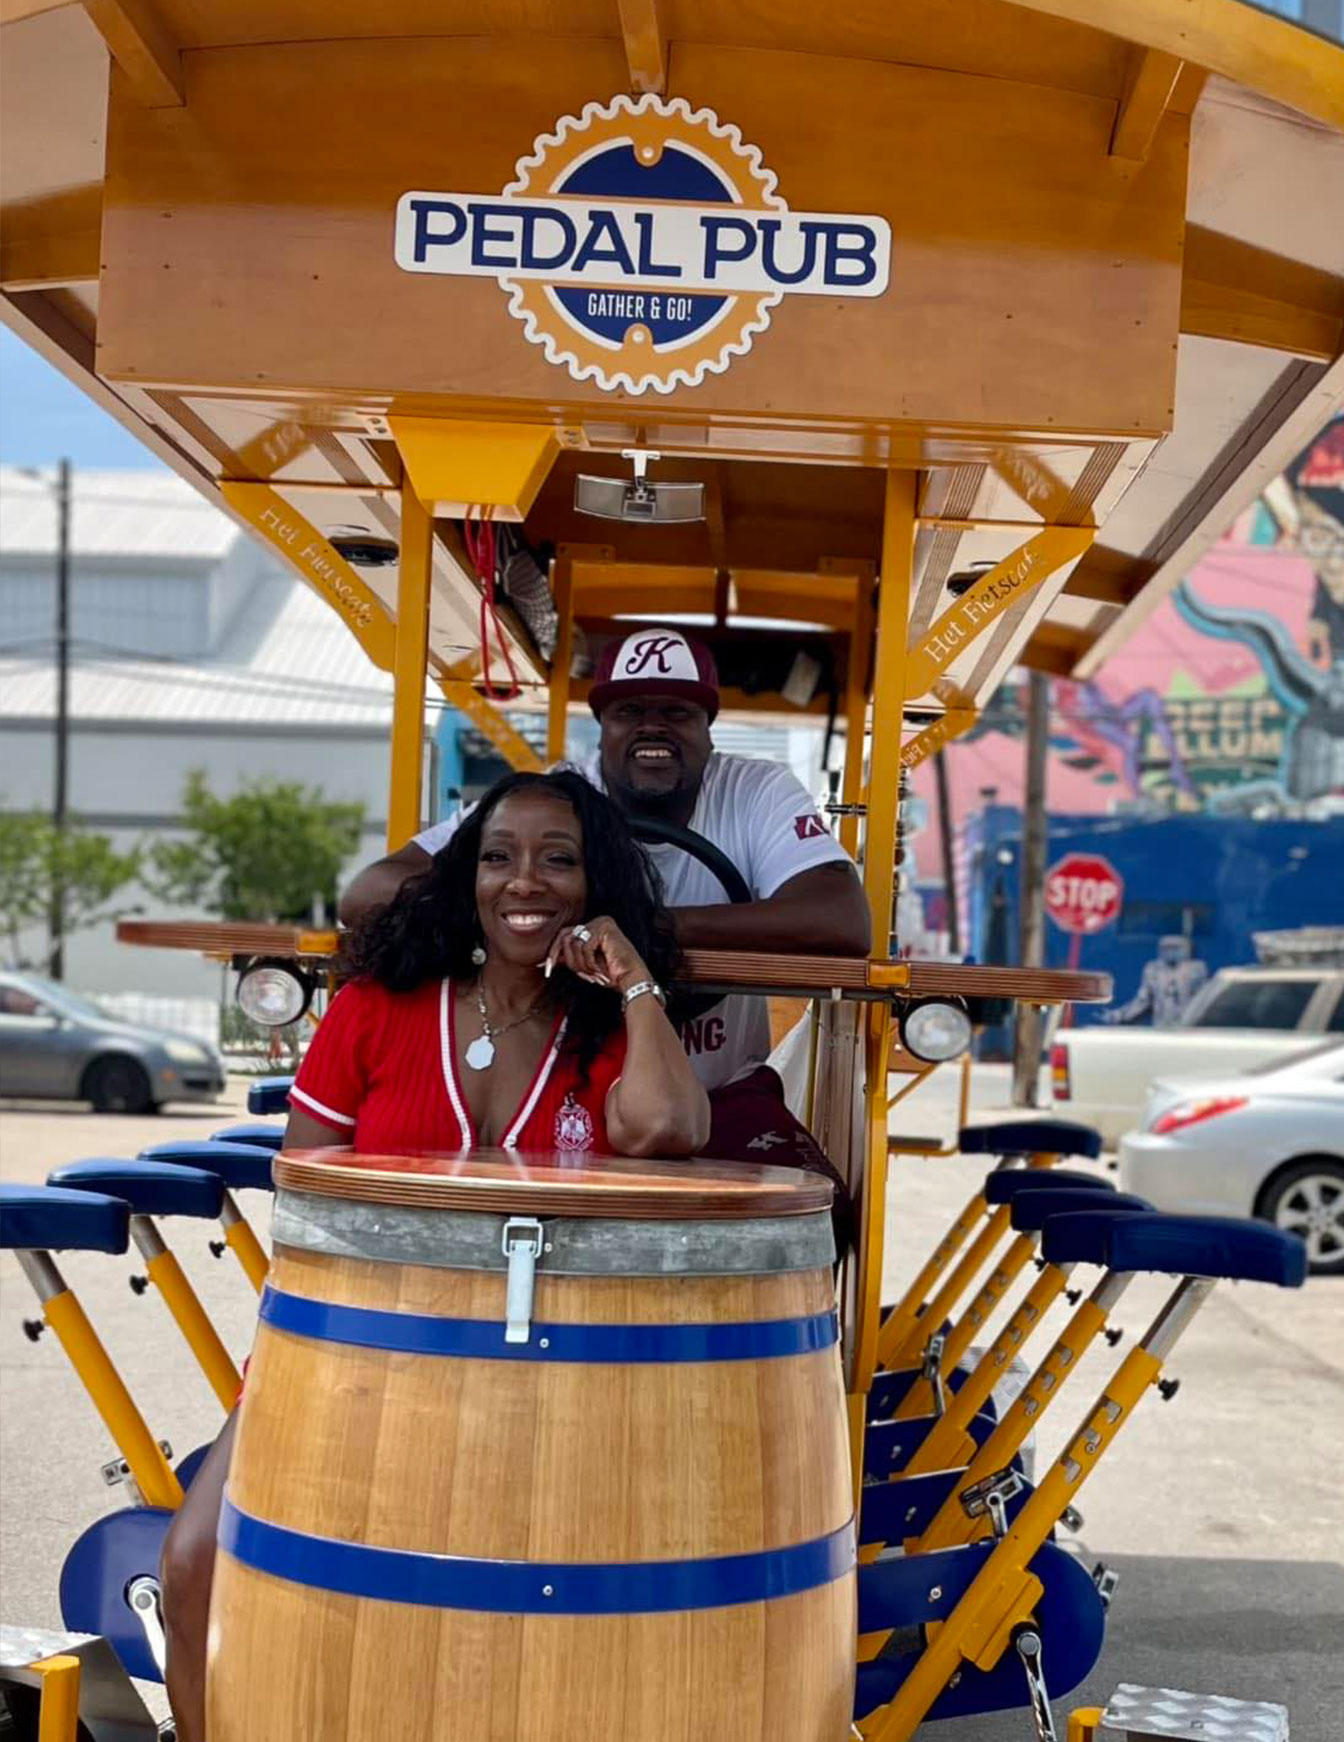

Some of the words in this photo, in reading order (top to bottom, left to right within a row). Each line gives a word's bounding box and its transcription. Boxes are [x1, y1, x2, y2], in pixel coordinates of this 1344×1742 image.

[410, 200, 682, 277] PEDAL
[700, 216, 877, 286] PUB
[587, 292, 645, 319] GATHER
[650, 297, 662, 321] &
[667, 298, 692, 322] GO!
[625, 636, 684, 675] K
[923, 620, 967, 663] Het
[1047, 875, 1118, 911] STOP
[683, 1016, 727, 1056] NG
